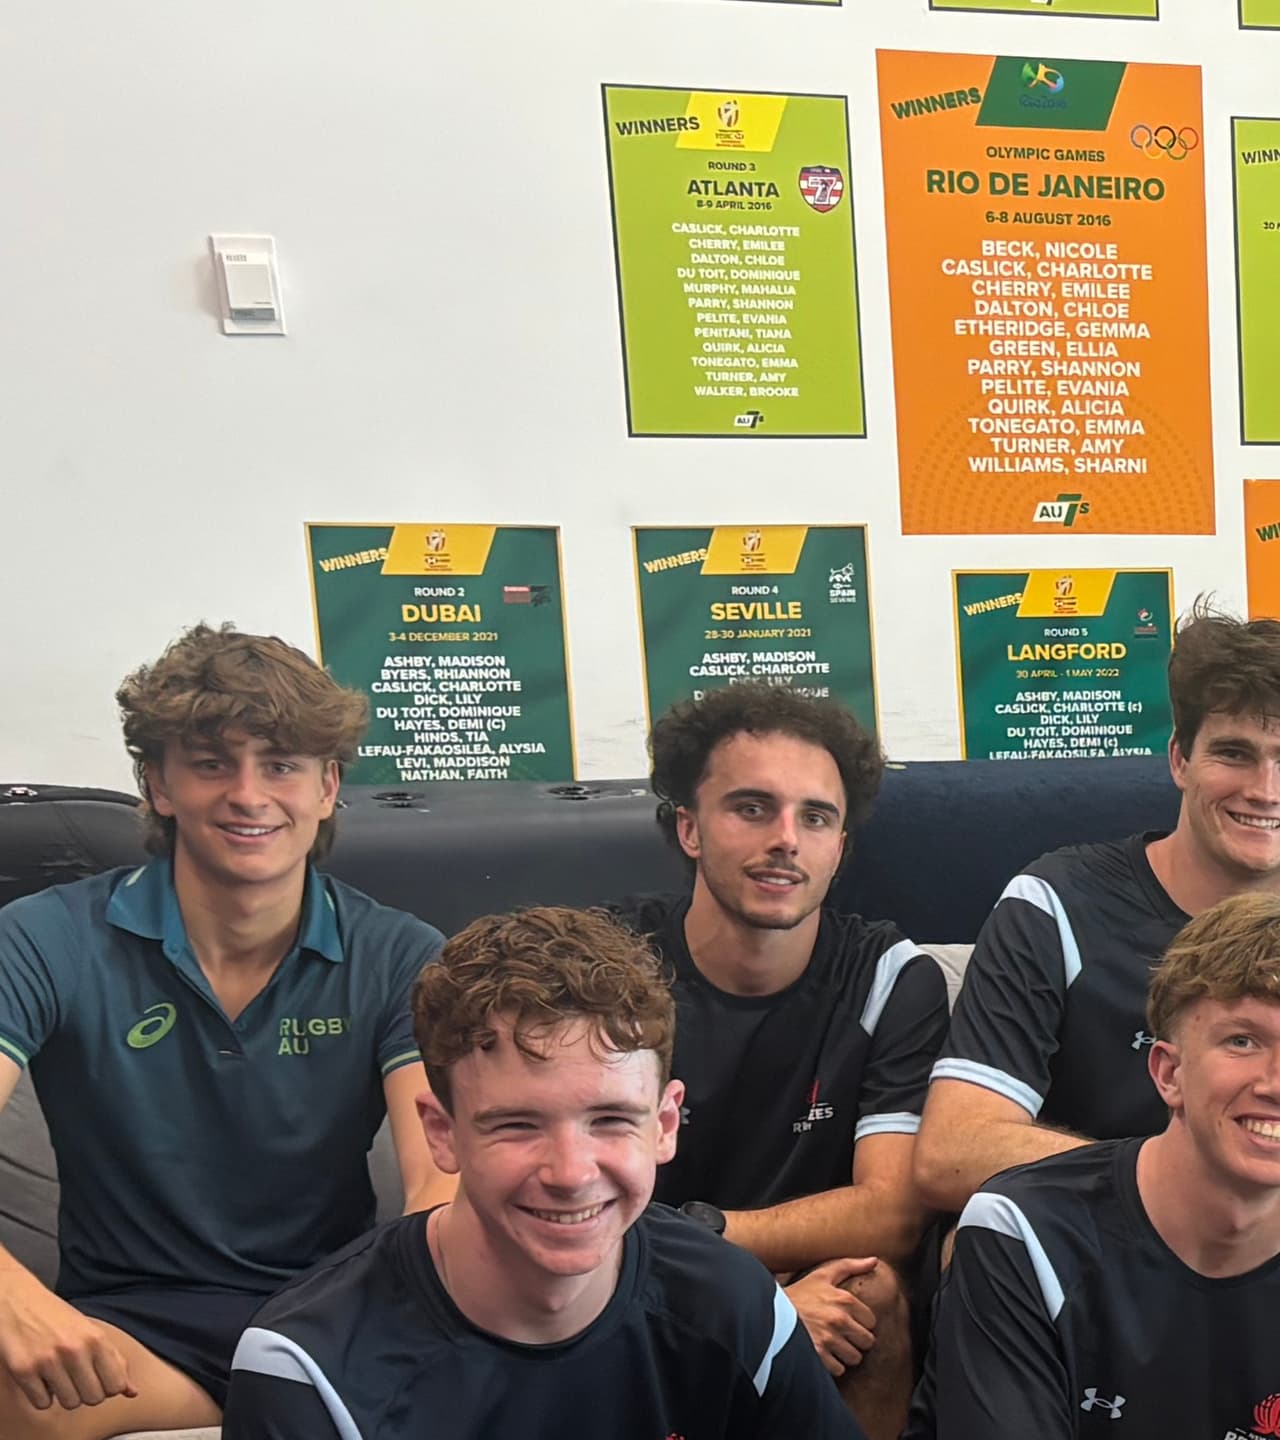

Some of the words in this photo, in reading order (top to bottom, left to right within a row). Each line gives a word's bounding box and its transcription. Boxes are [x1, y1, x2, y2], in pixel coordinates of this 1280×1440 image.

[891, 87, 982, 120] WINNERS
[615, 116, 699, 135] WINNERS
[986, 146, 1050, 160] OLYMPIC
[1054, 148, 1105, 162] GAMES
[707, 160, 747, 171] ROUND
[749, 162, 756, 171] 3
[687, 179, 779, 197] ATLANTA
[926, 169, 979, 194] RIO
[989, 171, 1028, 196] DE
[1038, 174, 1164, 200] JANEIRO
[985, 210, 1008, 223] 6-8
[1012, 212, 1073, 225] AUGUST
[1077, 213, 1111, 226] 2016
[671, 222, 726, 235] CASLICK,
[729, 224, 799, 236] CHARLOTTE
[981, 240, 1039, 258] BECK,
[1045, 242, 1117, 259] NICOLE
[941, 259, 1031, 278] CASLICK,
[1037, 261, 1151, 279] CHARLOTTE
[972, 279, 1055, 297] CHERRY,
[1061, 282, 1129, 299] EMILEE
[975, 299, 1058, 318] DALTON,
[1063, 301, 1128, 318] CHLOE
[954, 319, 1070, 337] ETHERIDGE,
[1075, 321, 1149, 338] GEMMA
[989, 339, 1060, 357] GREEN,
[1066, 341, 1118, 357] ELLIA
[967, 359, 1035, 376] PARRY,
[1041, 360, 1140, 376] SHANNON
[705, 371, 757, 382] TURNER,
[759, 372, 786, 382] AMY
[981, 378, 1051, 396] PELITE,
[1057, 379, 1128, 396] EVANIA
[988, 398, 1055, 415] QUIRK,
[1061, 399, 1123, 415] ALICIA
[968, 417, 1079, 435] TONEGATO,
[1085, 419, 1144, 434] EMMA
[990, 437, 1075, 454] TURNER,
[1080, 438, 1124, 453] AMY
[968, 456, 1068, 473] WILLIAMS,
[1074, 457, 1146, 473] SHARNI
[319, 547, 389, 573] WINNERS
[644, 547, 709, 574] WINNERS
[414, 587, 455, 596] ROUND
[457, 586, 464, 596] 2
[731, 585, 770, 595] ROUND
[771, 585, 778, 594] 4
[710, 601, 801, 620] SEVILLE
[963, 592, 1024, 616] WINNERS
[401, 604, 480, 622] DUBAI
[388, 631, 406, 641] 3-4
[408, 632, 469, 641] DECEMBER
[472, 631, 498, 641] 2021
[1043, 627, 1079, 636] ROUND
[1081, 627, 1088, 636] 5
[702, 652, 750, 664] ASHBY,
[752, 650, 815, 662] MADISON
[1007, 642, 1126, 660] LANGFORD
[384, 655, 435, 667] ASHBY,
[438, 655, 505, 666] MADISON
[689, 664, 749, 676] CASLICK,
[752, 662, 829, 674] CHARLOTTE
[371, 681, 436, 693] CASLICK,
[438, 680, 521, 692] CHARLOTTE
[413, 693, 452, 705] DICK,
[455, 693, 482, 704] LILY
[1015, 691, 1060, 701] ASHBY,
[1062, 690, 1121, 700] MADISON
[1040, 714, 1073, 724] DICK,
[1075, 713, 1099, 724] LILY
[414, 731, 463, 743] HINDS,
[465, 731, 488, 742] TIA
